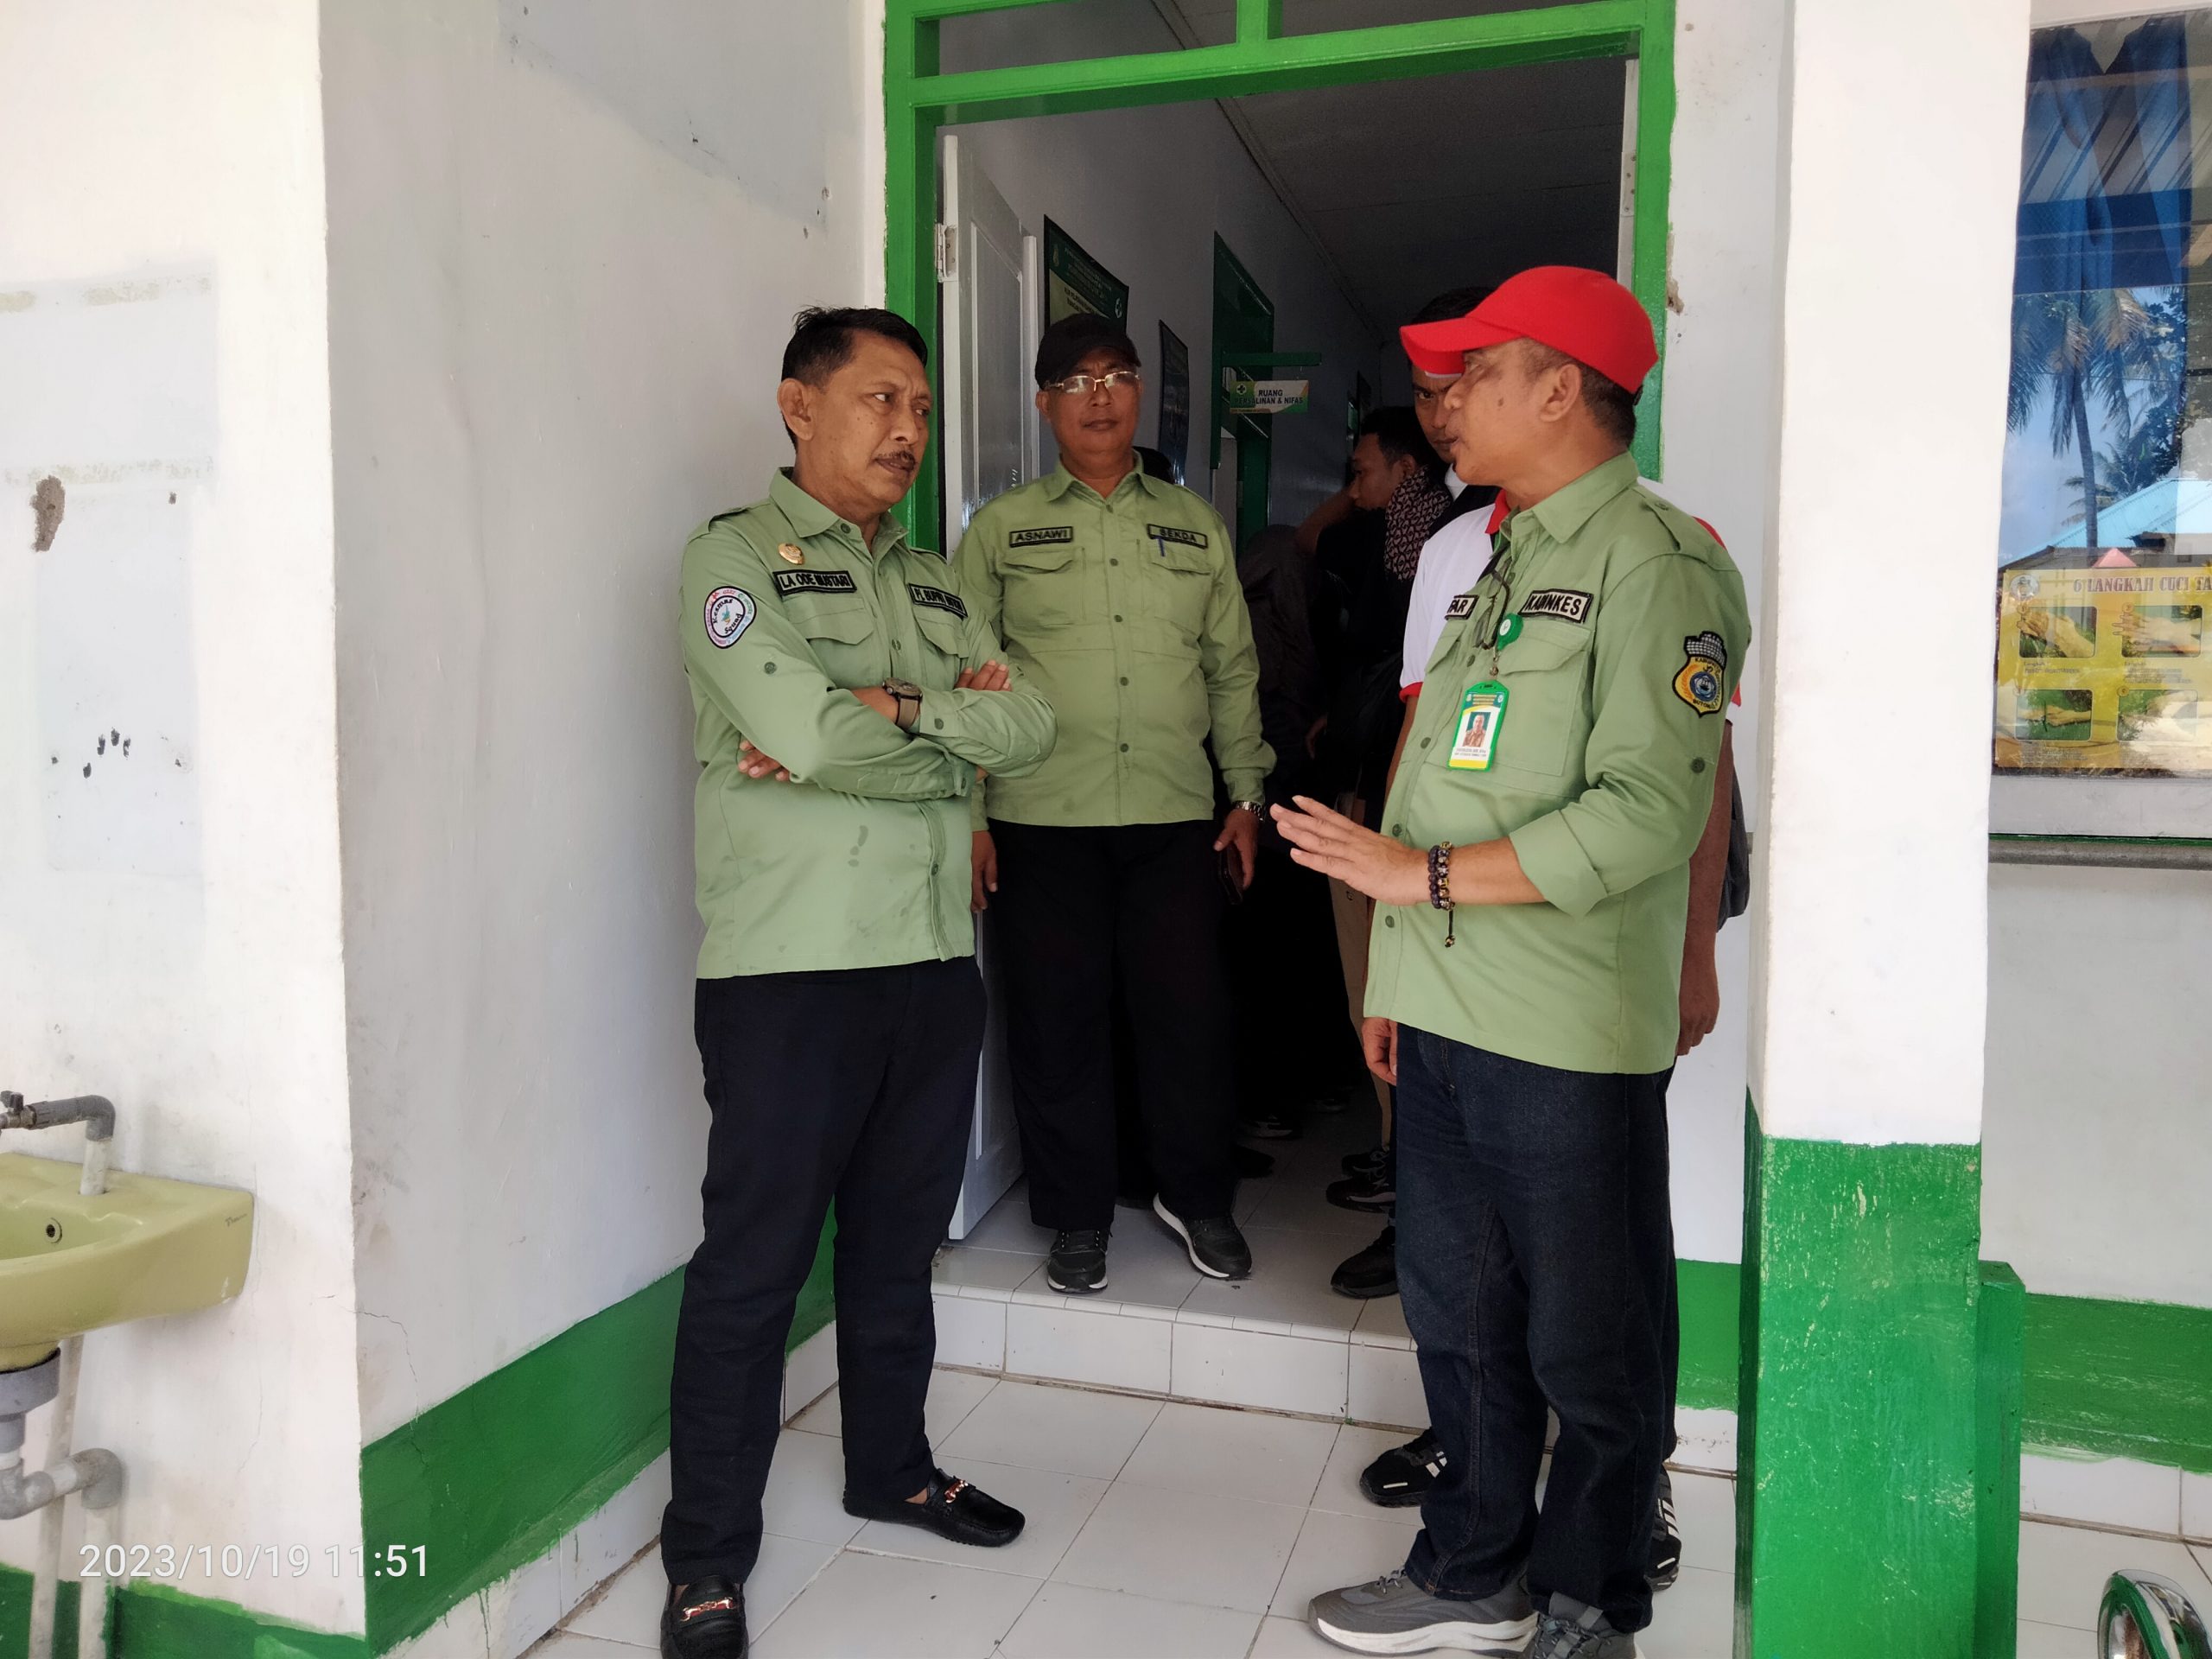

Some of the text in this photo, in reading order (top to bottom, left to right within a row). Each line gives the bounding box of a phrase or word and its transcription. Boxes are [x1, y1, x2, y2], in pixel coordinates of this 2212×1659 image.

[1014, 530, 1068, 542] ASNAWI
[1159, 527, 1198, 543] SEKDA
[779, 574, 796, 588] LA
[795, 573, 816, 586] ODE
[2074, 578, 2082, 593] 6
[2087, 576, 2154, 592] LANGKAH
[2159, 575, 2190, 591] CUCI
